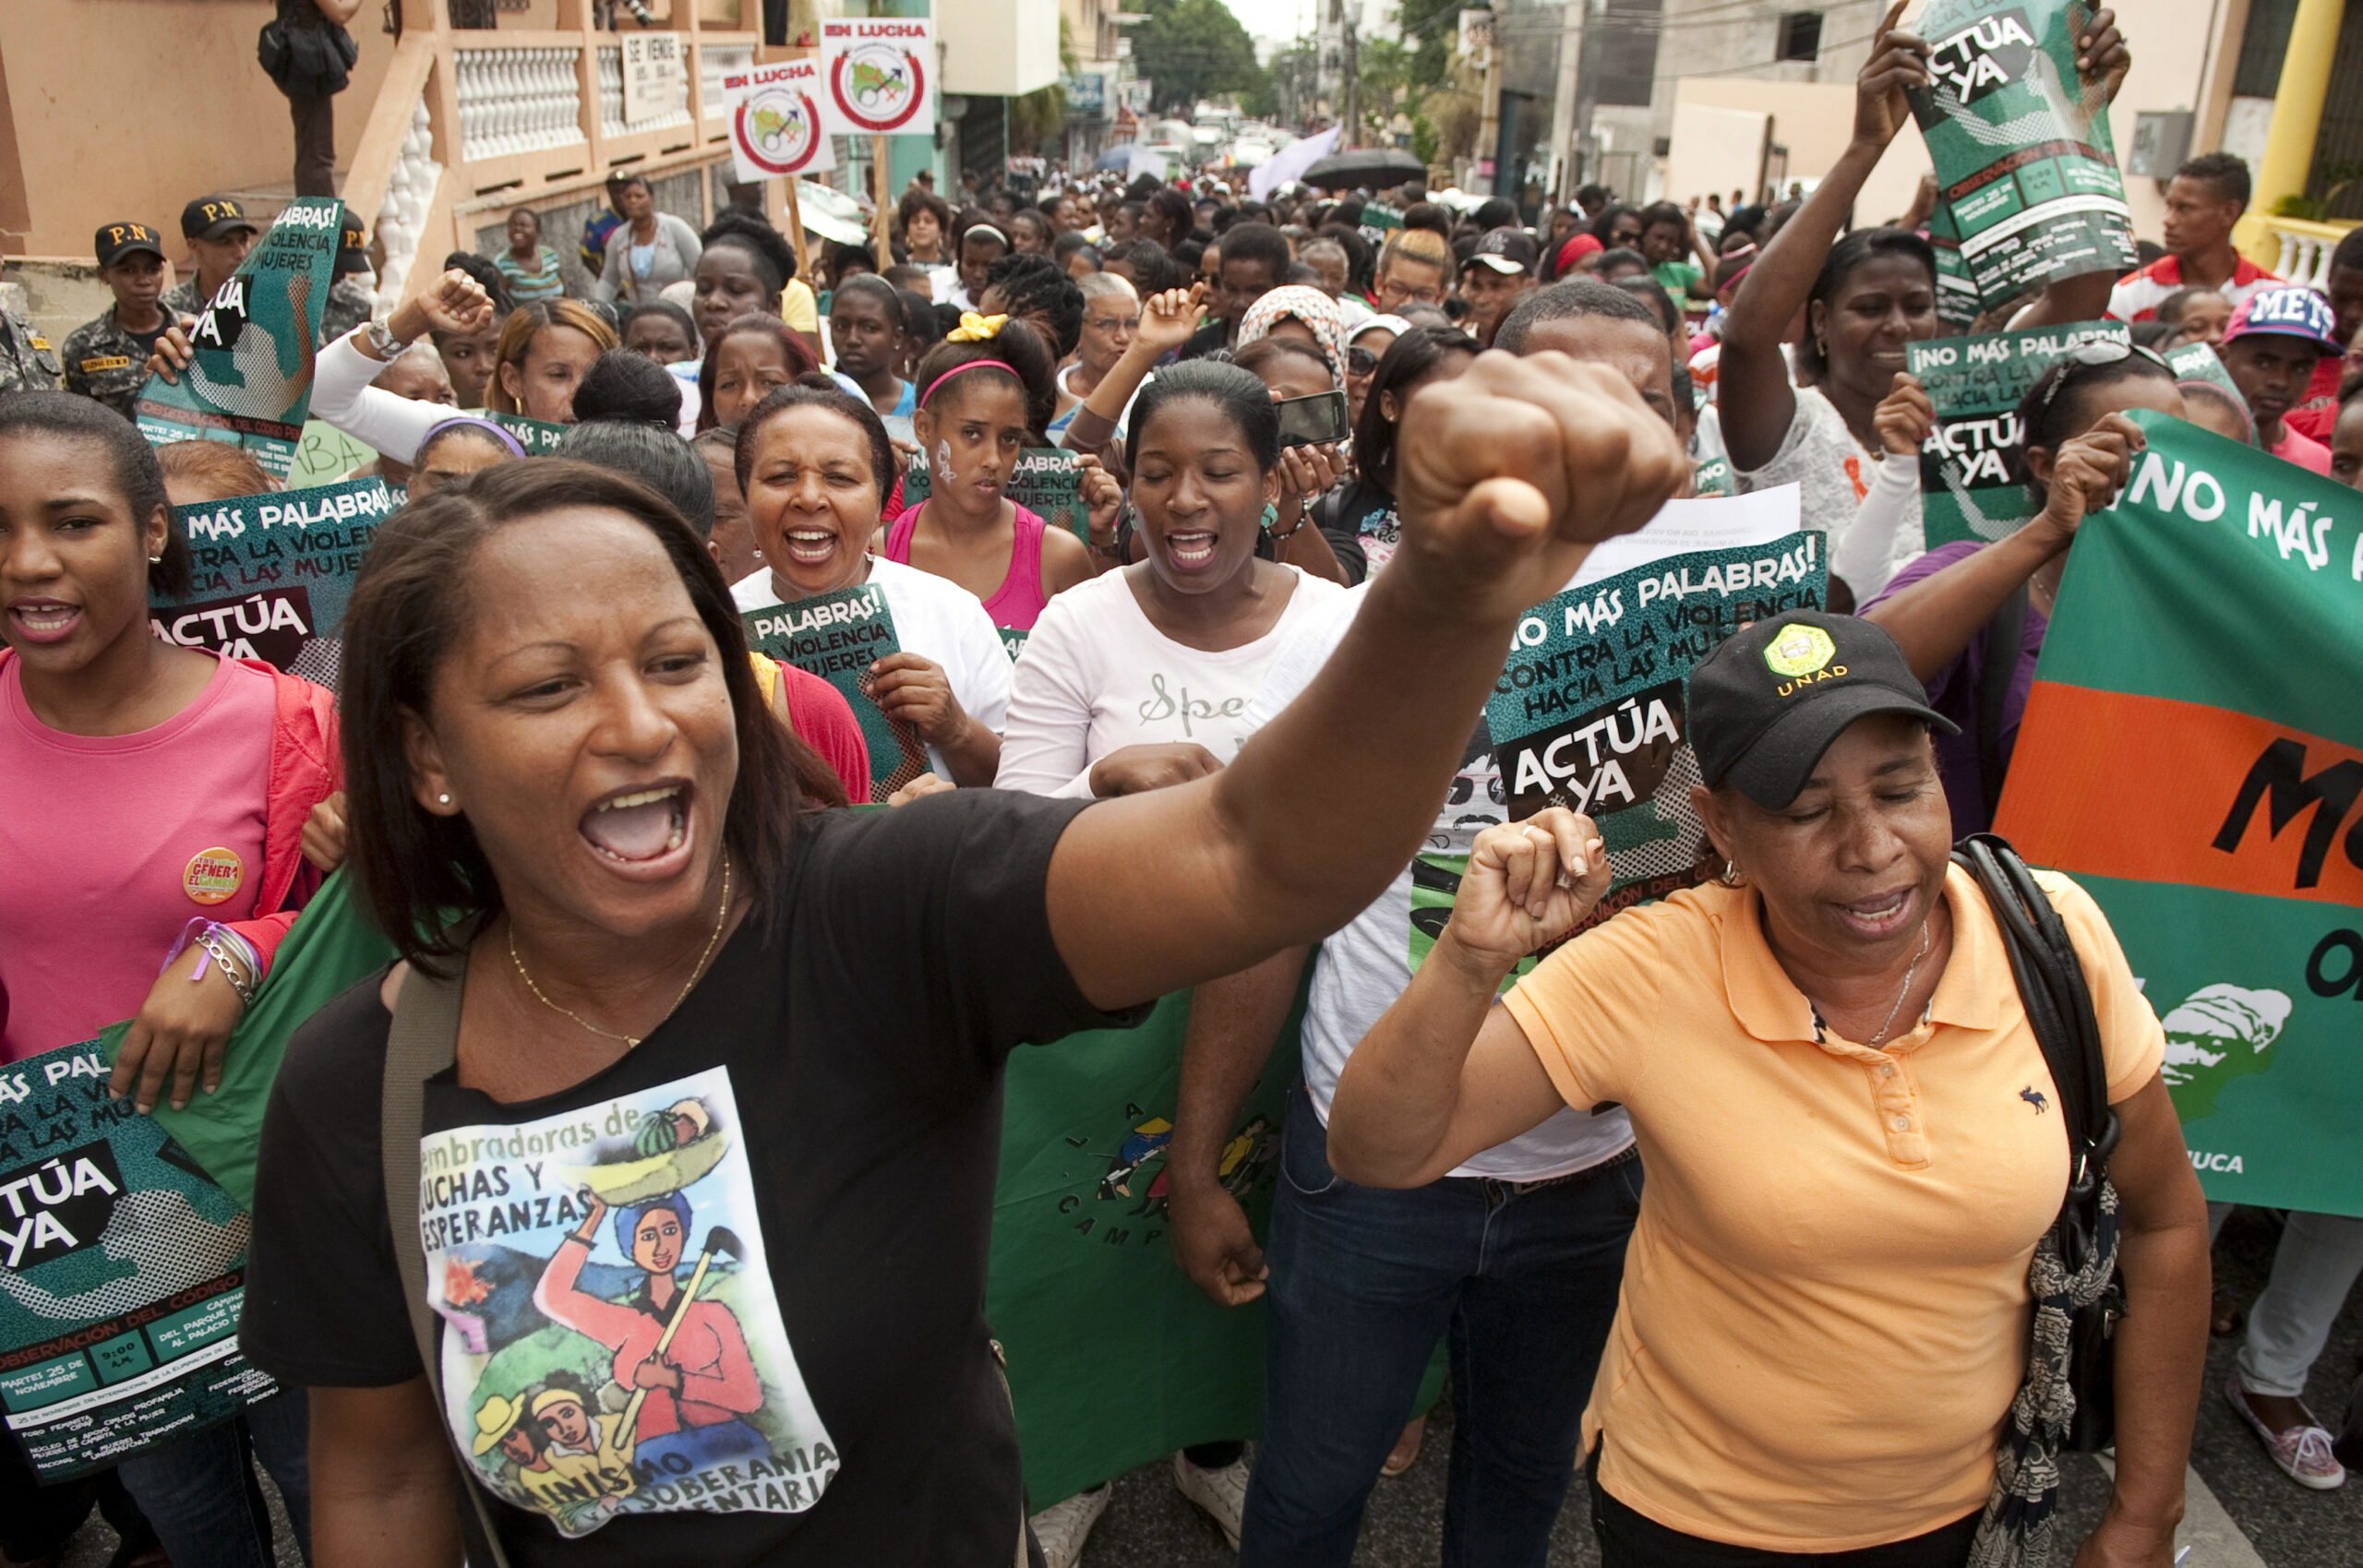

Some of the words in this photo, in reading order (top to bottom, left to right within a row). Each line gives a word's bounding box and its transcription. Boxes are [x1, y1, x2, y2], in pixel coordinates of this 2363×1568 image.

[858, 25, 926, 37] LUCHA
[628, 39, 641, 63] SE
[647, 38, 675, 60] VENDE
[753, 65, 815, 84] LUCHA
[1949, 53, 2009, 103] YA
[108, 223, 154, 246] P.N.
[187, 309, 222, 347] YA
[1967, 338, 2010, 365] MÁS
[169, 428, 183, 439] 25
[1958, 449, 2010, 487] YA
[188, 507, 246, 541] MÁS
[259, 480, 393, 531] PALABRAS!
[2248, 491, 2333, 571] MÁS
[249, 540, 284, 559] LA
[240, 561, 282, 585] LAS
[1565, 588, 1624, 636] MÁS
[1637, 535, 1816, 608] PALABRAS!
[754, 586, 883, 640] PALABRAS!
[1625, 621, 1659, 651] LA
[1524, 674, 1605, 721] HACIA
[1613, 652, 1656, 686] LAS
[1777, 664, 1848, 698] UNAD
[1514, 696, 1680, 796] ACTÚA
[1566, 758, 1636, 814] YA
[1650, 877, 1687, 895] DEL
[36, 1094, 78, 1119] LA
[605, 1103, 643, 1137] de
[29, 1118, 78, 1151] LAS
[525, 1161, 544, 1191] Y
[2187, 1150, 2244, 1175] UCA
[422, 1188, 596, 1252] ESPERANZAS
[0, 1210, 79, 1268] YA
[126, 1308, 164, 1328] DEL
[170, 1274, 239, 1311] CÓDIGO
[159, 1329, 181, 1343] DEL
[183, 1309, 227, 1332] PARQUE
[172, 1337, 186, 1348] AL
[187, 1318, 230, 1341] PALACIO
[102, 1342, 136, 1361] 9:00
[1, 1371, 44, 1390] MARTES
[46, 1363, 66, 1380] 25
[68, 1359, 85, 1371] DE
[15, 1371, 78, 1396] NOVIEMBRE
[22, 1429, 46, 1439] FORO
[29, 1442, 63, 1455] NÚCLEO
[82, 1426, 111, 1440] APOYO
[138, 1407, 166, 1422] MUJER
[36, 1456, 76, 1470] NACIONAL
[639, 1442, 839, 1511] SOBERANIA
